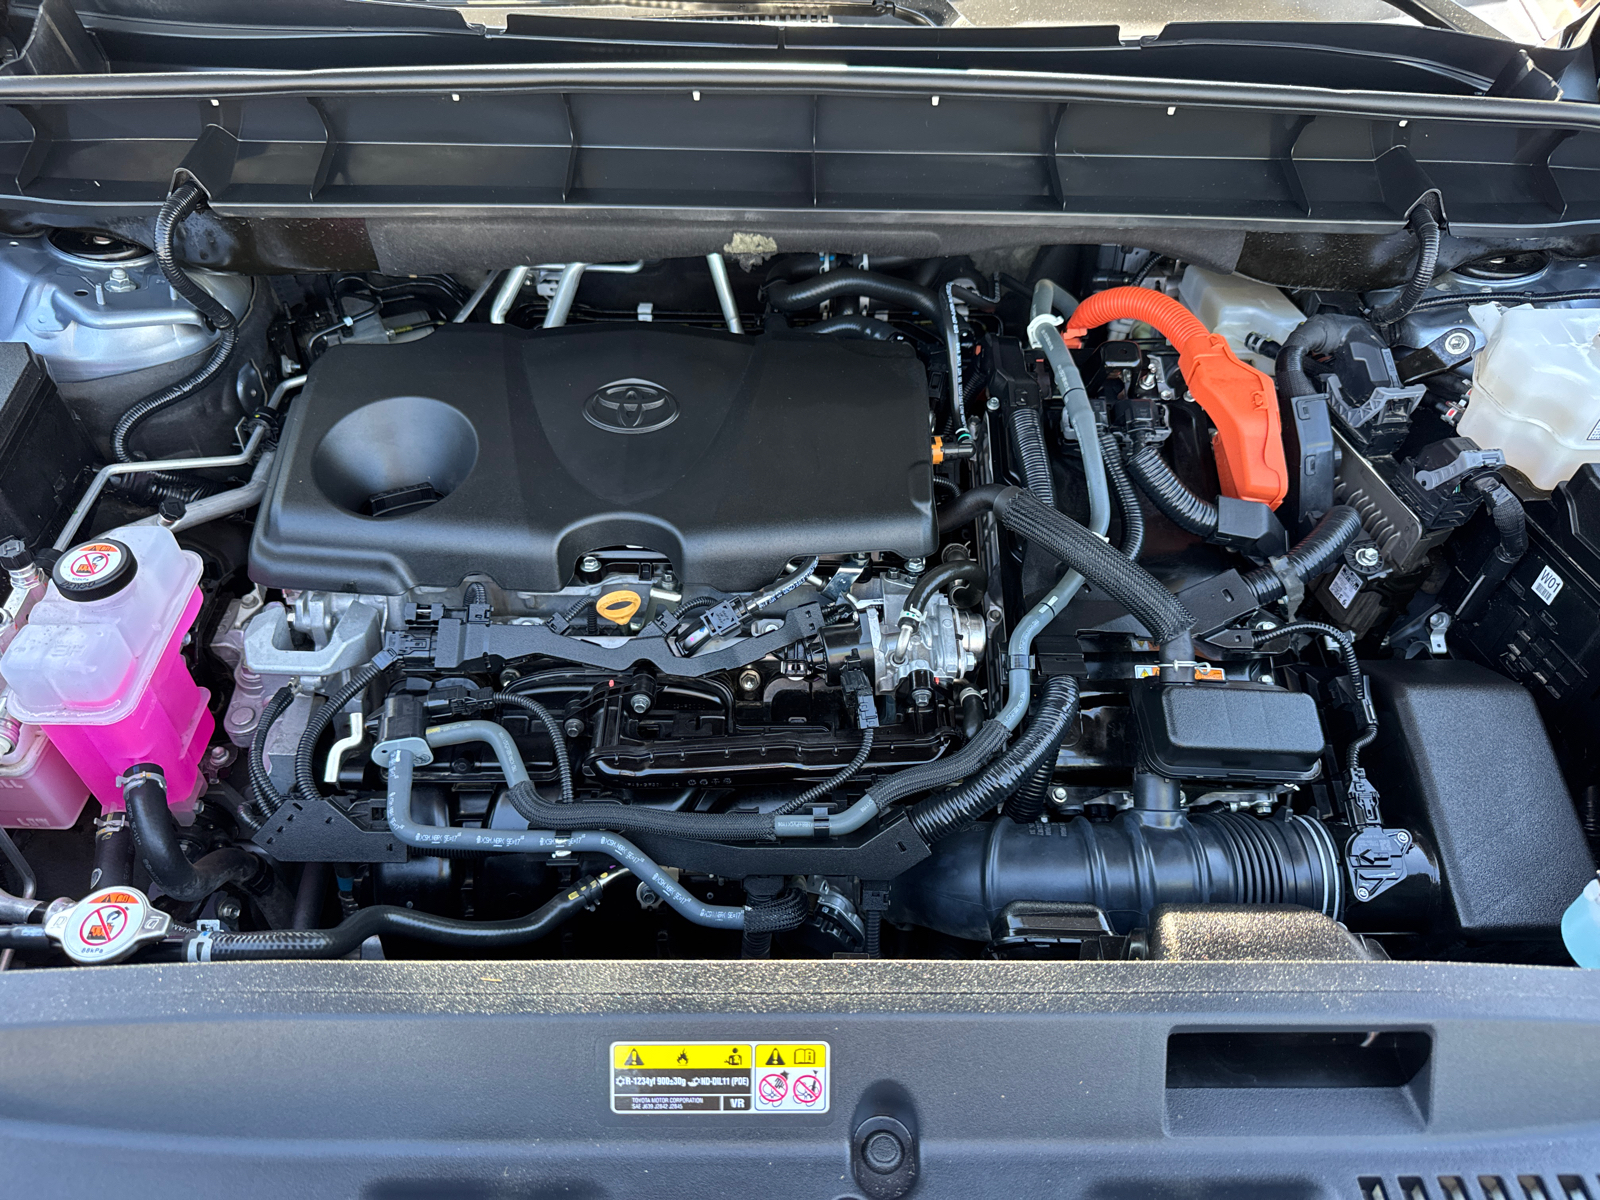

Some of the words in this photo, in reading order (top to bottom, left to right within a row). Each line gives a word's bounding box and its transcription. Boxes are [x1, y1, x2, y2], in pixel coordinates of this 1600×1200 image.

[60, 581, 97, 590] DENSO
[1540, 569, 1561, 593] W01
[16, 817, 50, 827] LOW
[731, 1076, 750, 1087] (POE)
[730, 1098, 746, 1109] VR
